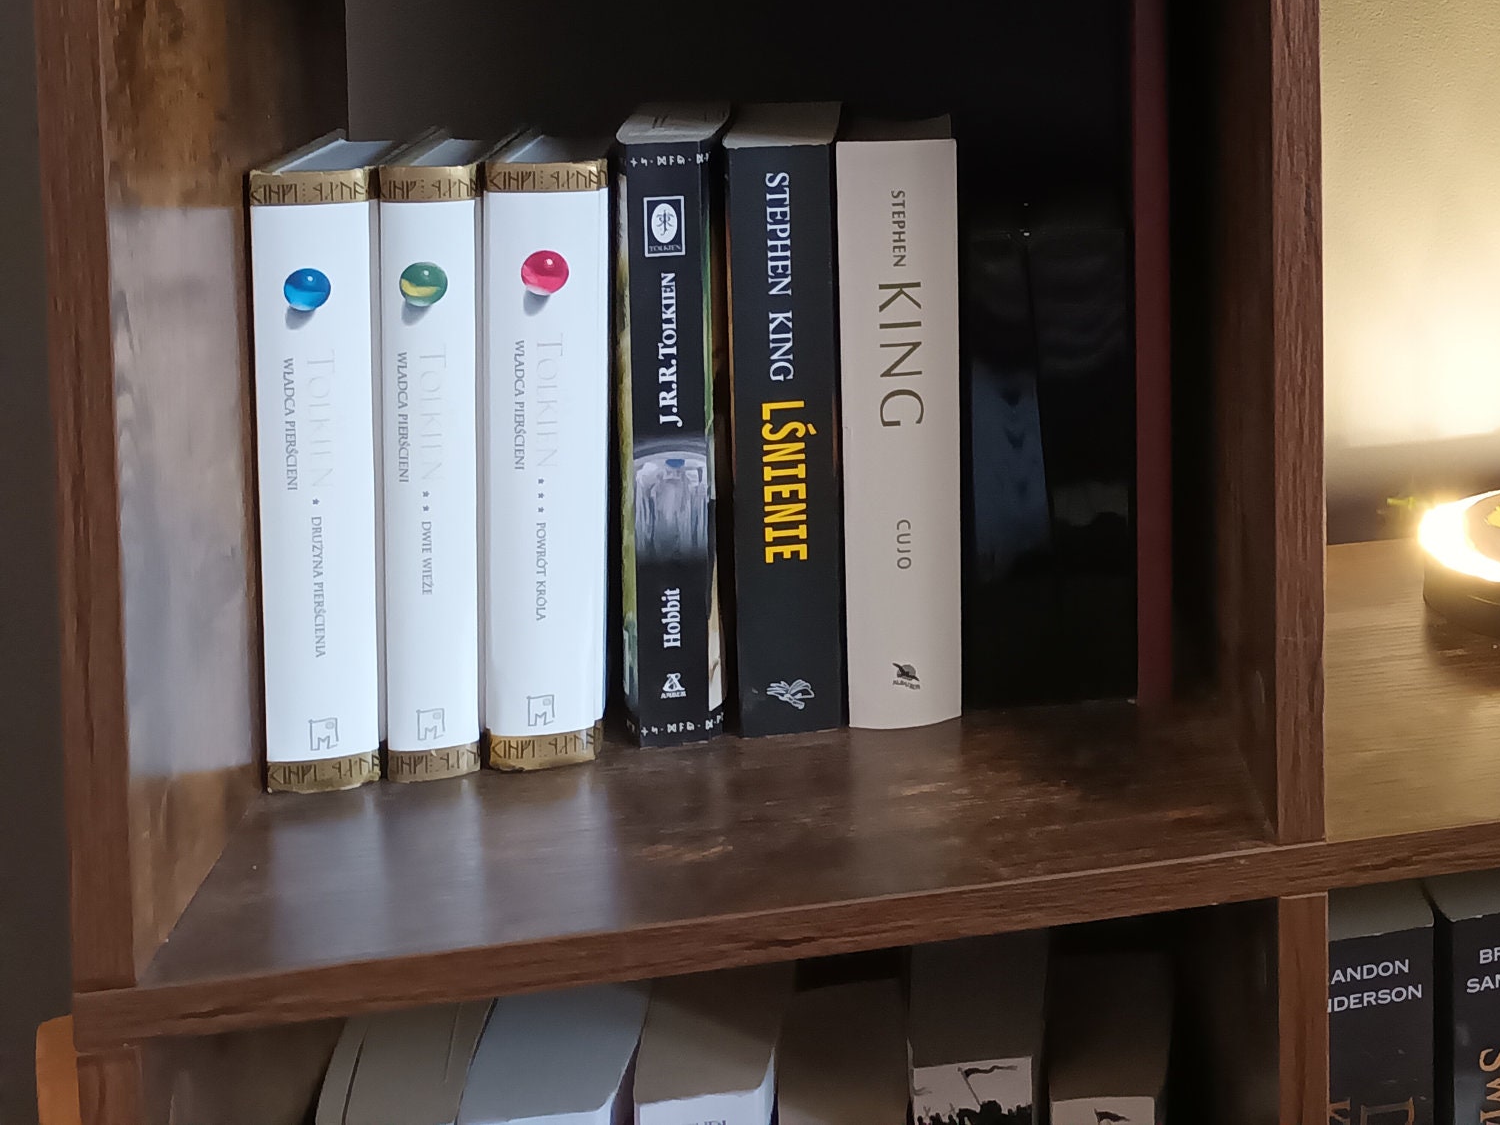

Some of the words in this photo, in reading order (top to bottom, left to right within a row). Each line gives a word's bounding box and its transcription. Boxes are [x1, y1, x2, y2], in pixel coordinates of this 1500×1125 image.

[765, 172, 792, 296] STEPHEN
[890, 190, 907, 268] STEPHEN
[514, 340, 525, 397] WŁADCA
[768, 311, 794, 382] KING
[878, 281, 925, 428] KING
[283, 357, 296, 416] WŁADCA
[397, 351, 409, 410] WŁADCA
[285, 420, 299, 491] PIERŚCIENI
[398, 413, 411, 483] PIERŚCIENI
[514, 401, 527, 470] PIERŚCIENI
[761, 400, 818, 564] LŚNIENIE
[311, 516, 324, 579] DRUŻYNA
[421, 520, 433, 554] DWIE
[536, 522, 548, 577] POWRÓT
[897, 519, 912, 570] CUJO
[421, 557, 433, 596] WIEŻE
[536, 581, 548, 622] KRÓLA
[313, 581, 326, 659] PIERŚCIENIA
[661, 588, 681, 648] Hobbit
[1329, 958, 1410, 986] ANDON
